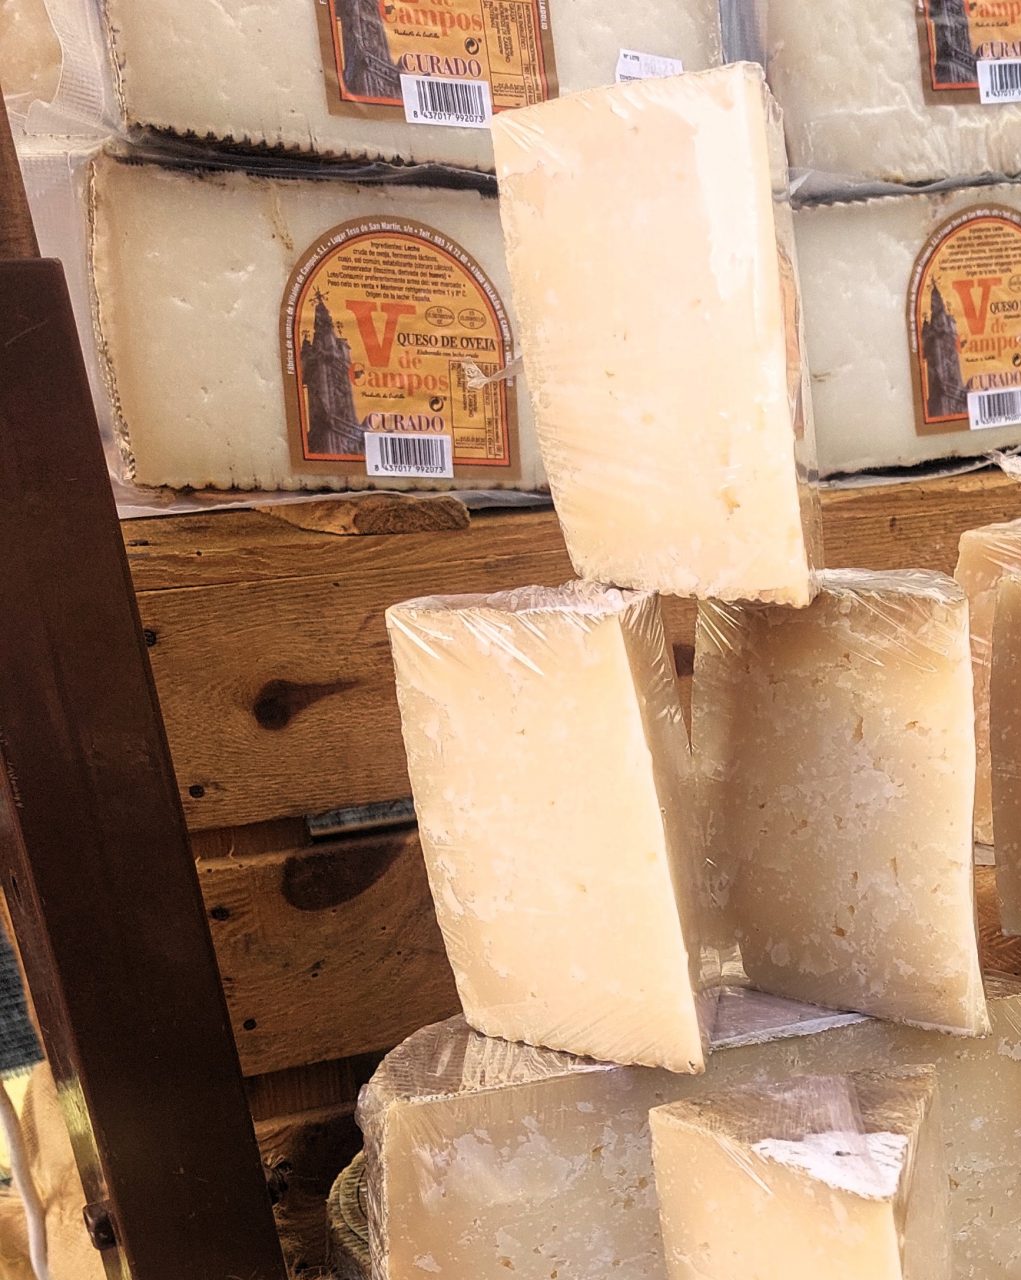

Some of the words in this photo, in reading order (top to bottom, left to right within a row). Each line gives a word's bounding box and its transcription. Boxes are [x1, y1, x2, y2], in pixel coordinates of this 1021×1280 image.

[381, 0, 482, 37] Campos
[403, 54, 482, 77] CURADO
[413, 110, 418, 118] 8
[423, 112, 451, 121] 437017
[455, 114, 484, 123] 992073
[951, 277, 1003, 336] V
[990, 300, 1018, 315] QUESO
[345, 299, 417, 368] V
[397, 332, 439, 348] QUESO
[441, 335, 457, 348] DE
[460, 337, 496, 351] OVEJA
[398, 351, 422, 369] de
[349, 362, 449, 396] Campos
[368, 412, 445, 432] CURADO
[374, 464, 379, 472] 8
